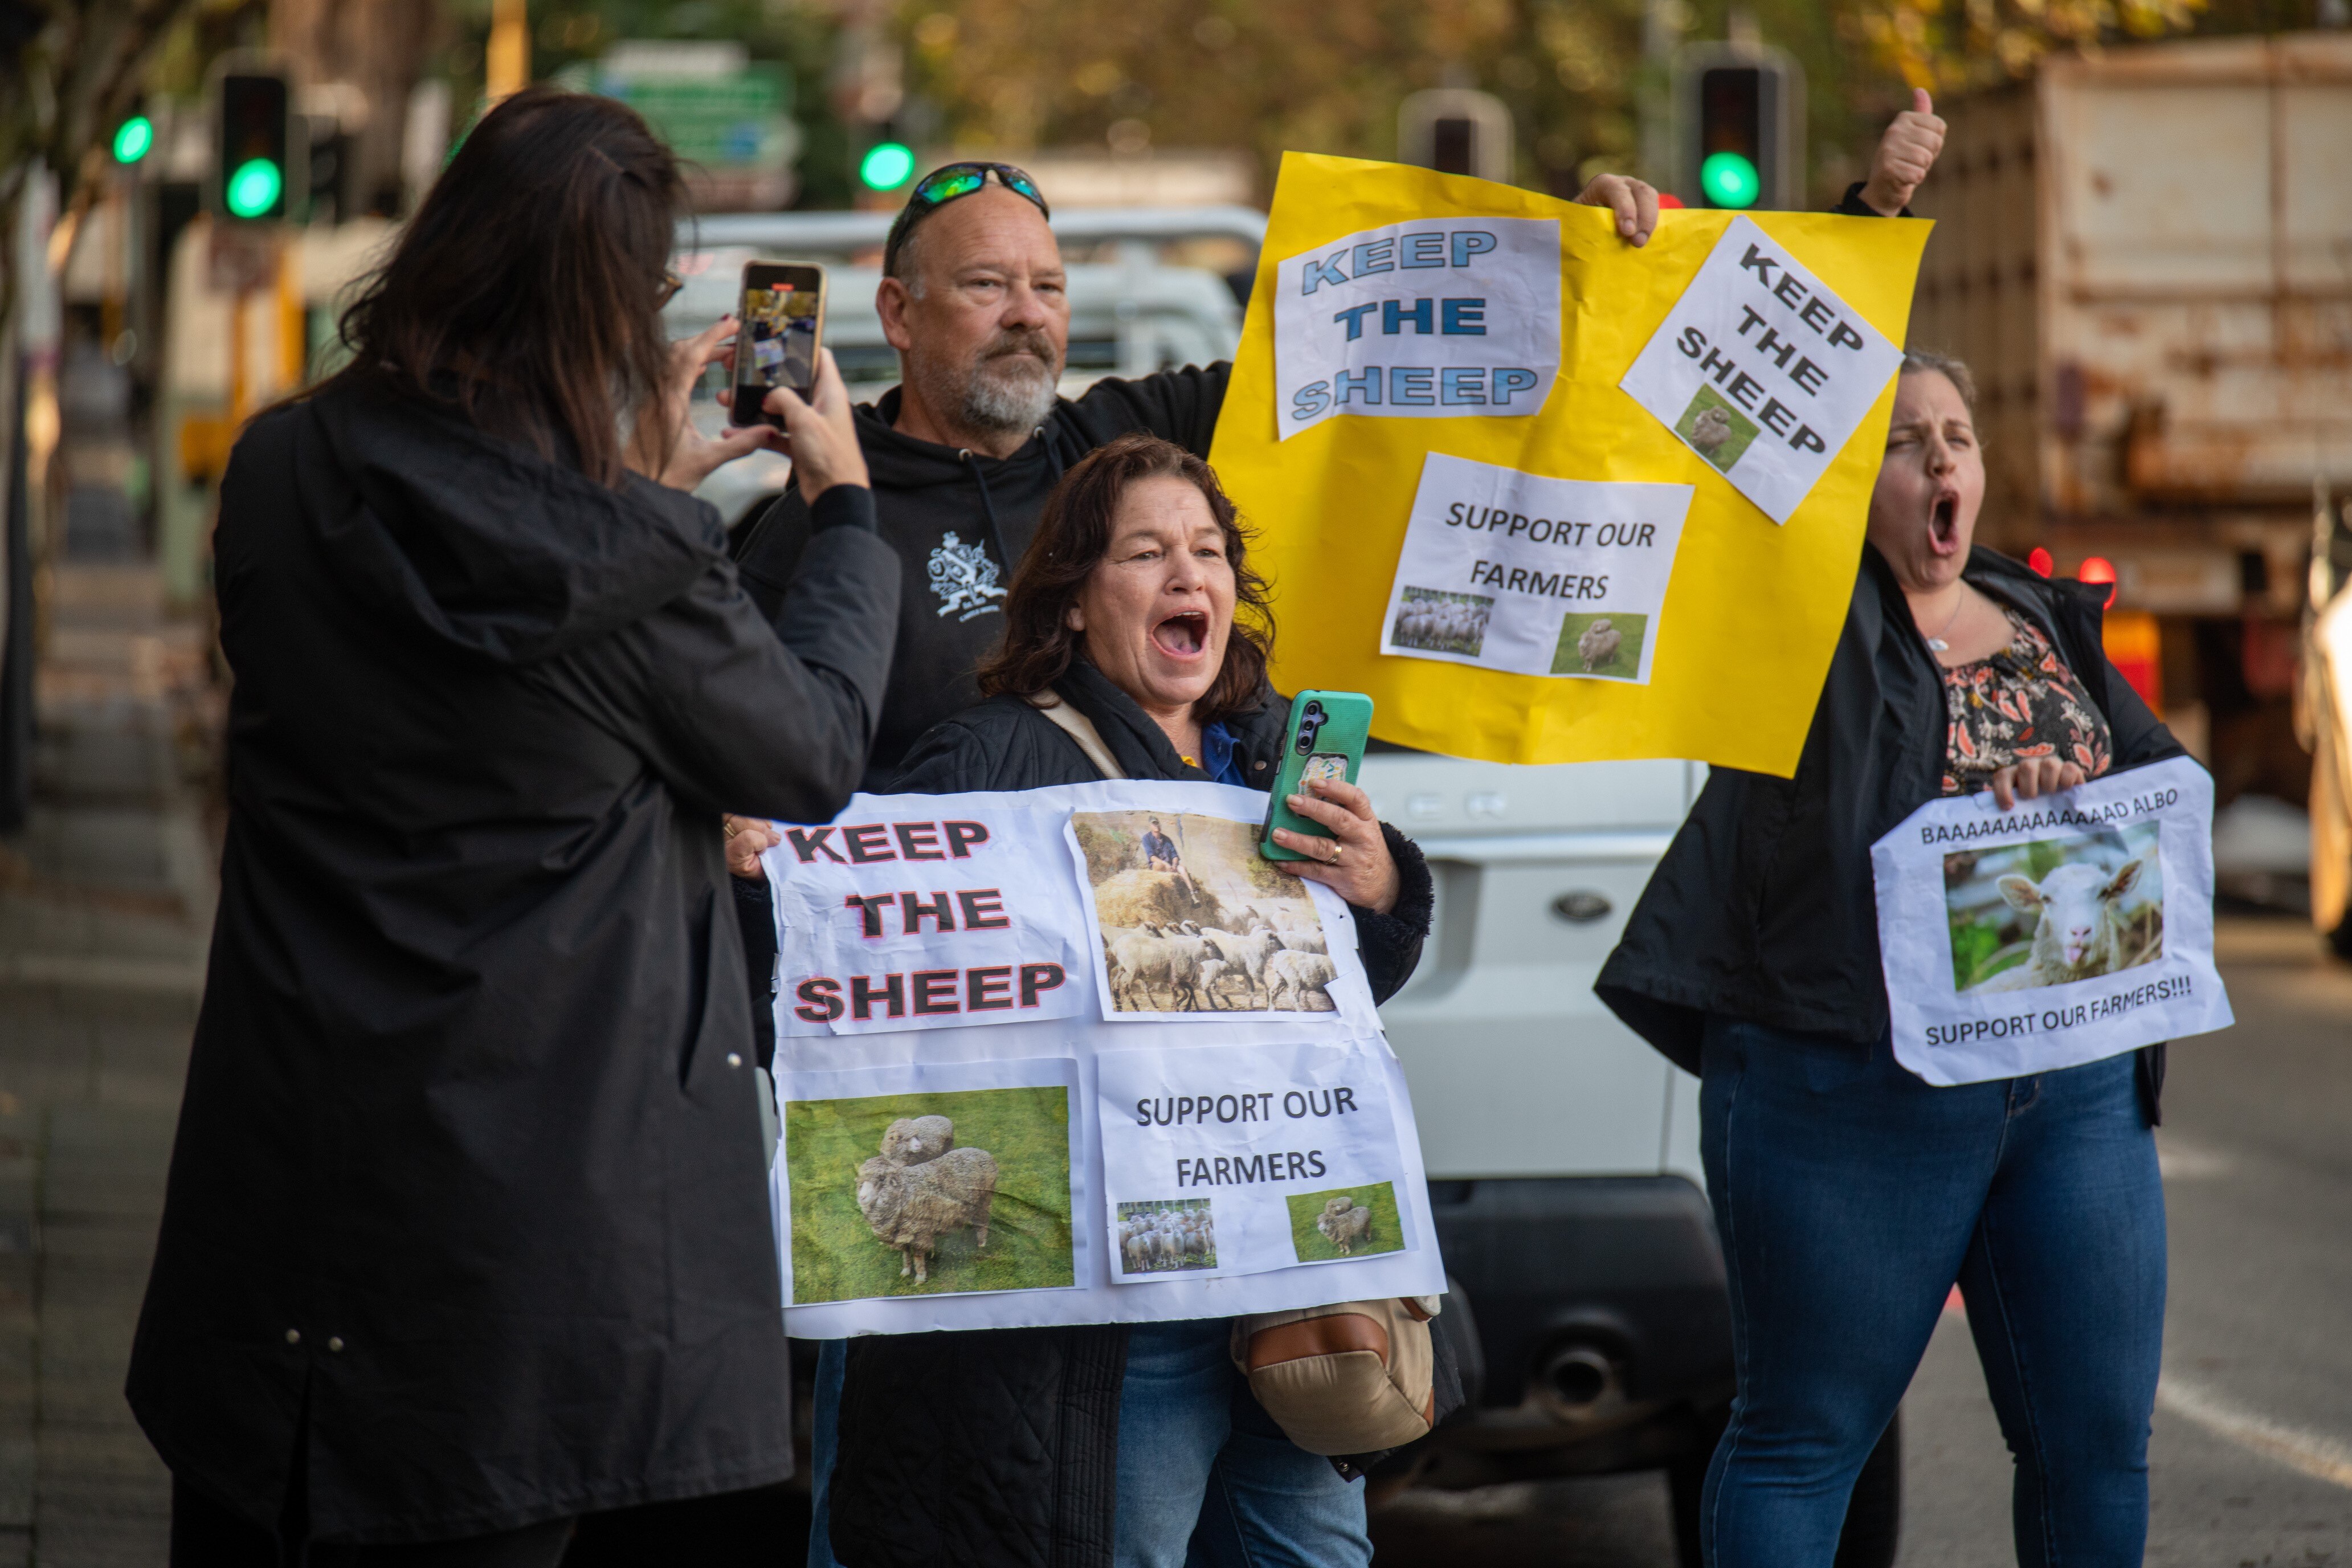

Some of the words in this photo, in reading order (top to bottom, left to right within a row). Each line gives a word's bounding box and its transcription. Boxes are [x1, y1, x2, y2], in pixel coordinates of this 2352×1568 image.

[1302, 231, 1497, 296] KEEP
[1334, 298, 1487, 341] THE
[1740, 243, 1864, 351] KEEP
[1737, 304, 1829, 397] THE
[1291, 366, 1537, 420] SHEEP
[1677, 326, 1826, 454] SHEEP
[1446, 502, 1591, 546] SUPPORT
[1596, 522, 1656, 547] OUR
[1470, 560, 1609, 599] FARMERS
[2134, 789, 2178, 815] ALBO
[785, 820, 990, 865] KEEP
[844, 888, 1010, 938] THE
[794, 962, 1065, 1023] SHEEP
[1926, 1014, 2036, 1047] SUPPORT
[2043, 1006, 2088, 1030] OUR
[2091, 975, 2192, 1020] FARMERS!!!
[1137, 1093, 1273, 1126] SUPPORT
[1284, 1087, 1358, 1118] OUR
[1177, 1150, 1326, 1187] FARMERS
